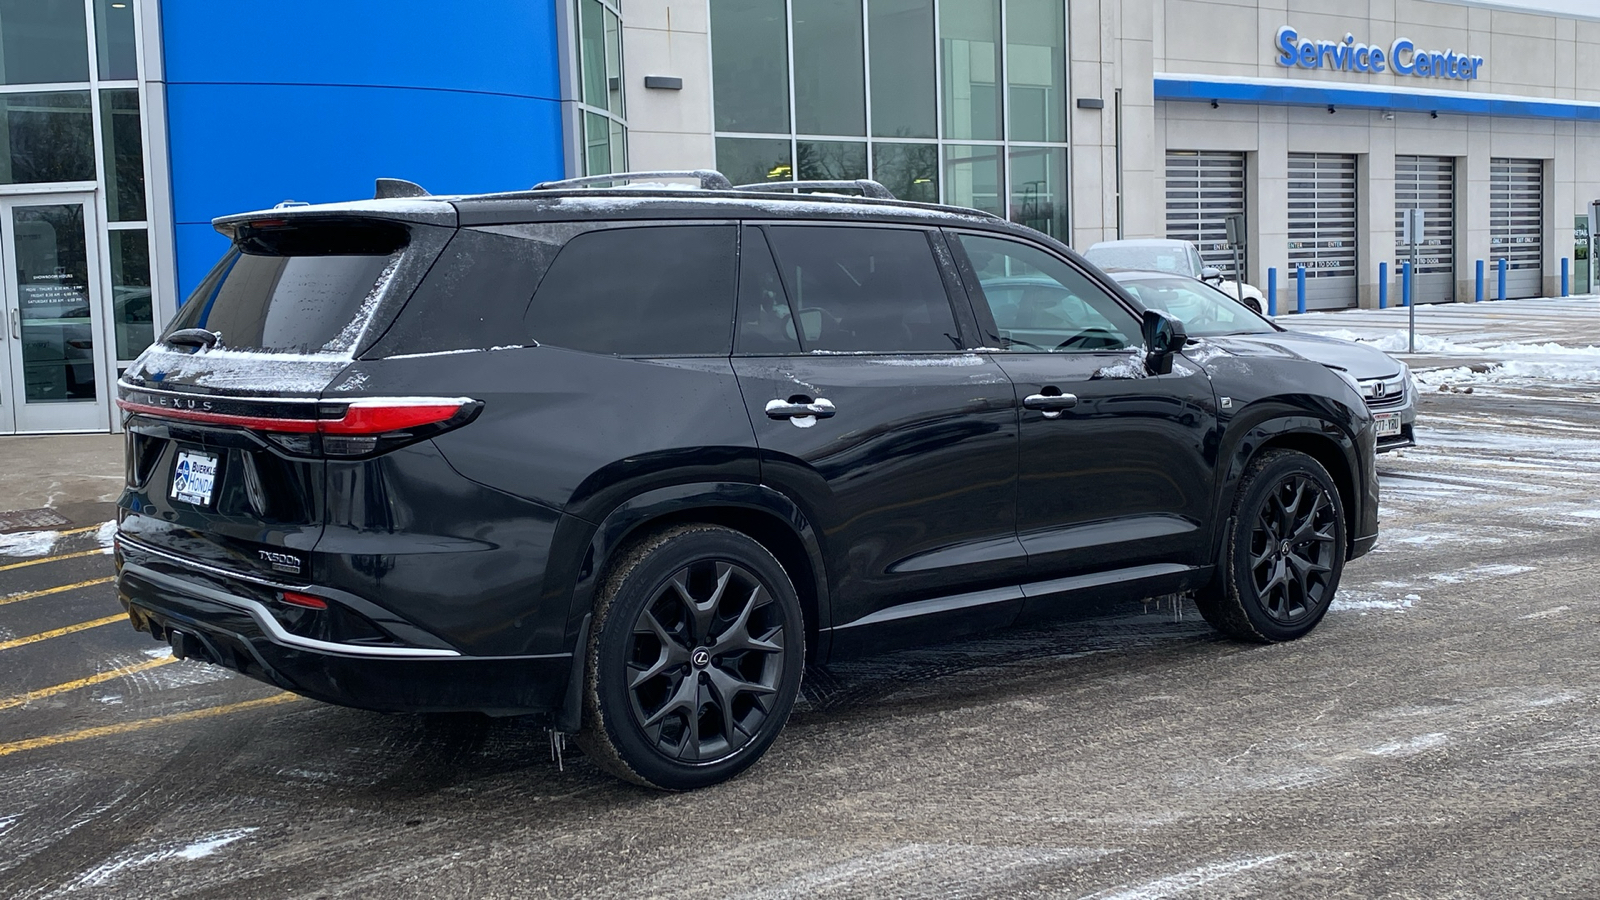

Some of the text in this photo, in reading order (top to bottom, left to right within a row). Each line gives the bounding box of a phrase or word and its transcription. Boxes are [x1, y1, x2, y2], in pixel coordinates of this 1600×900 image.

[1276, 26, 1483, 80] Service Center
[147, 395, 212, 411] LEXUS
[191, 461, 217, 476] BUERKLE
[188, 473, 214, 493] HONDA
[258, 550, 300, 566] TX500h
